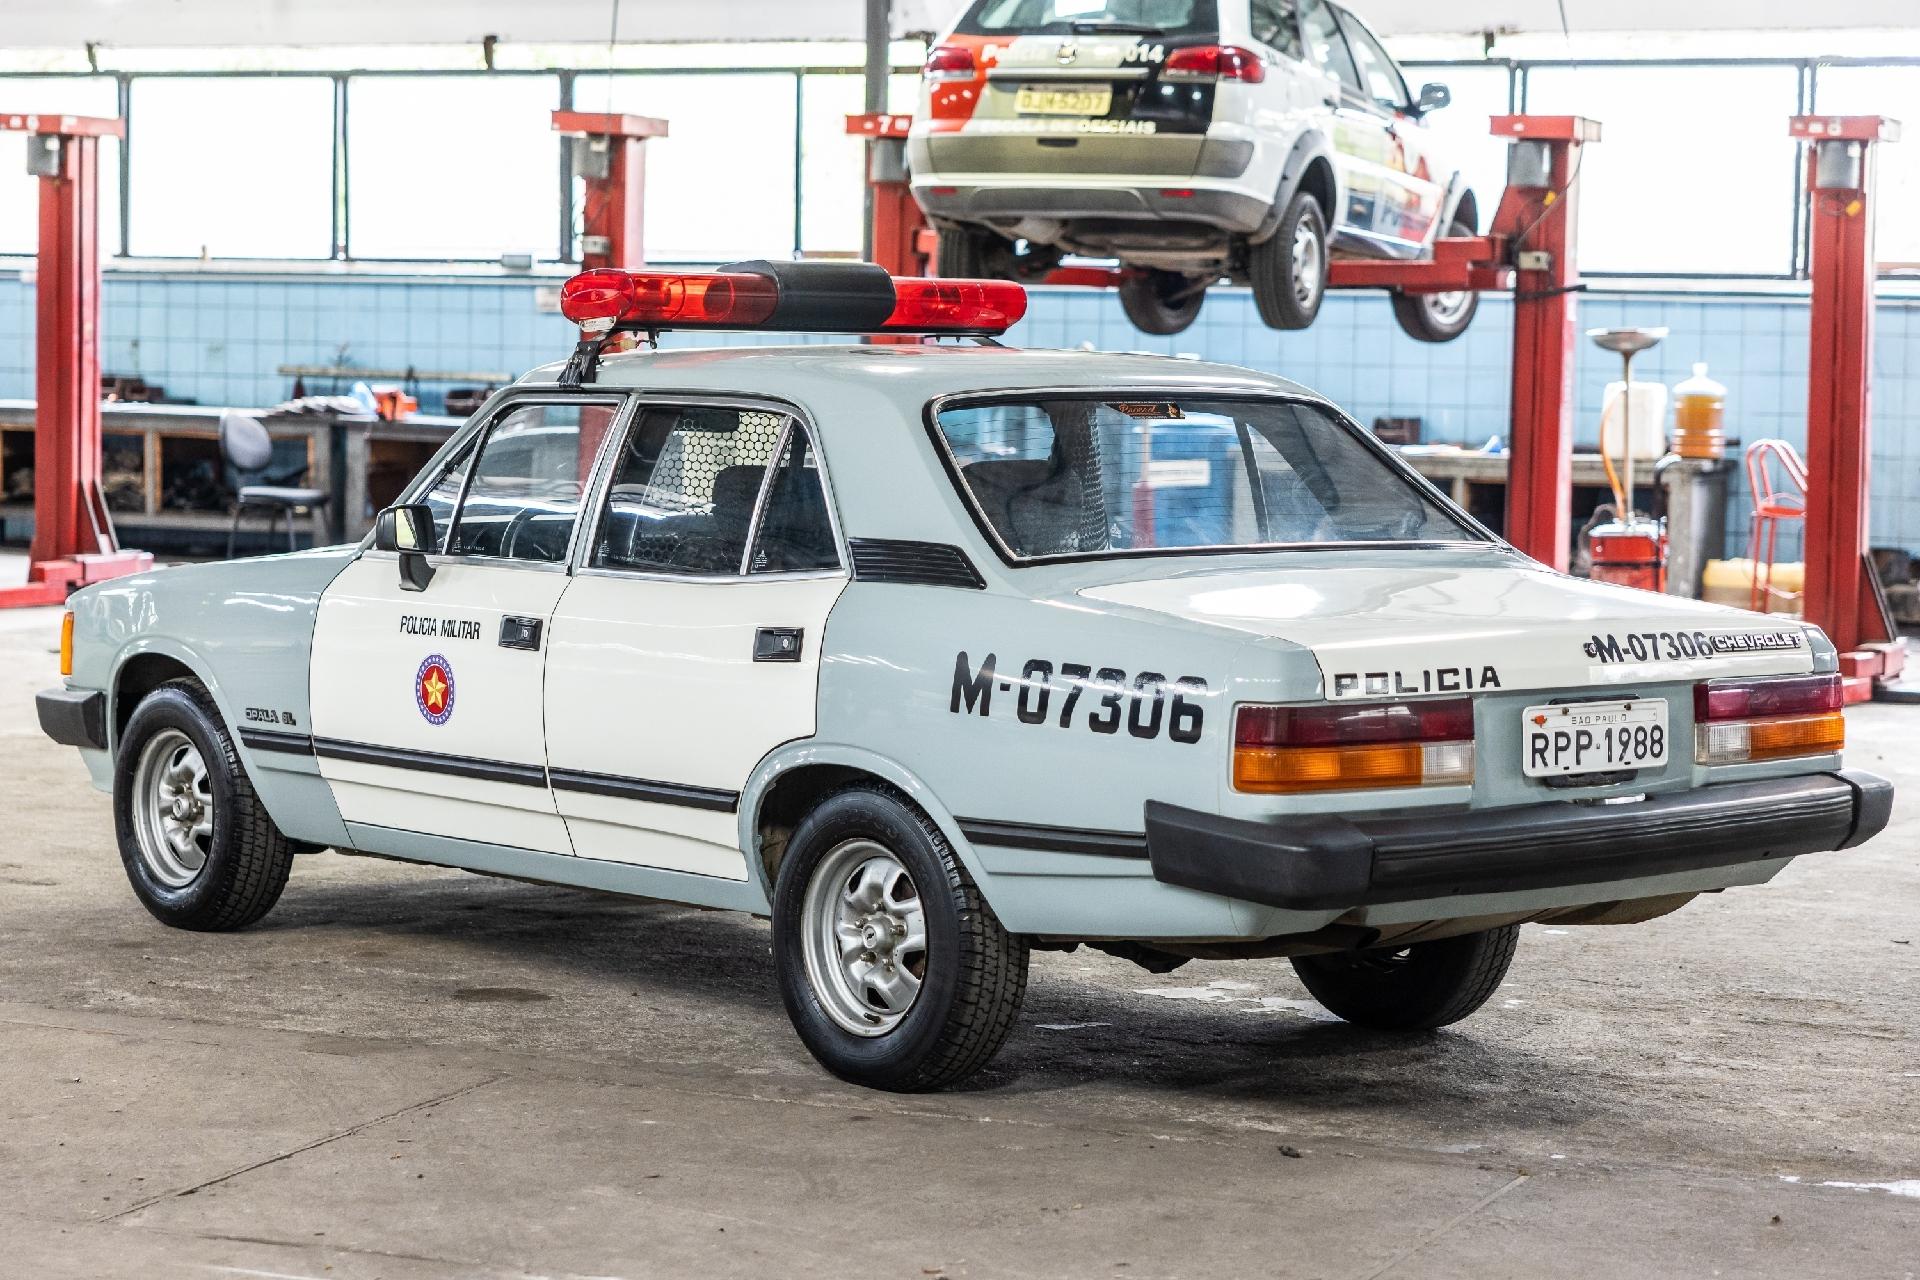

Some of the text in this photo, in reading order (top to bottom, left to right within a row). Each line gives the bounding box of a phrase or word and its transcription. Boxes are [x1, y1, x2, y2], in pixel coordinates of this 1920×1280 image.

[400, 615, 481, 640] POLICIA MILITAR
[1591, 631, 1802, 663] M-07306 CHEVROLET
[1334, 665, 1502, 696] POLICIA
[949, 650, 1209, 744] M-07306
[245, 707, 280, 723] OPALA
[1595, 713, 1627, 724] PAULO
